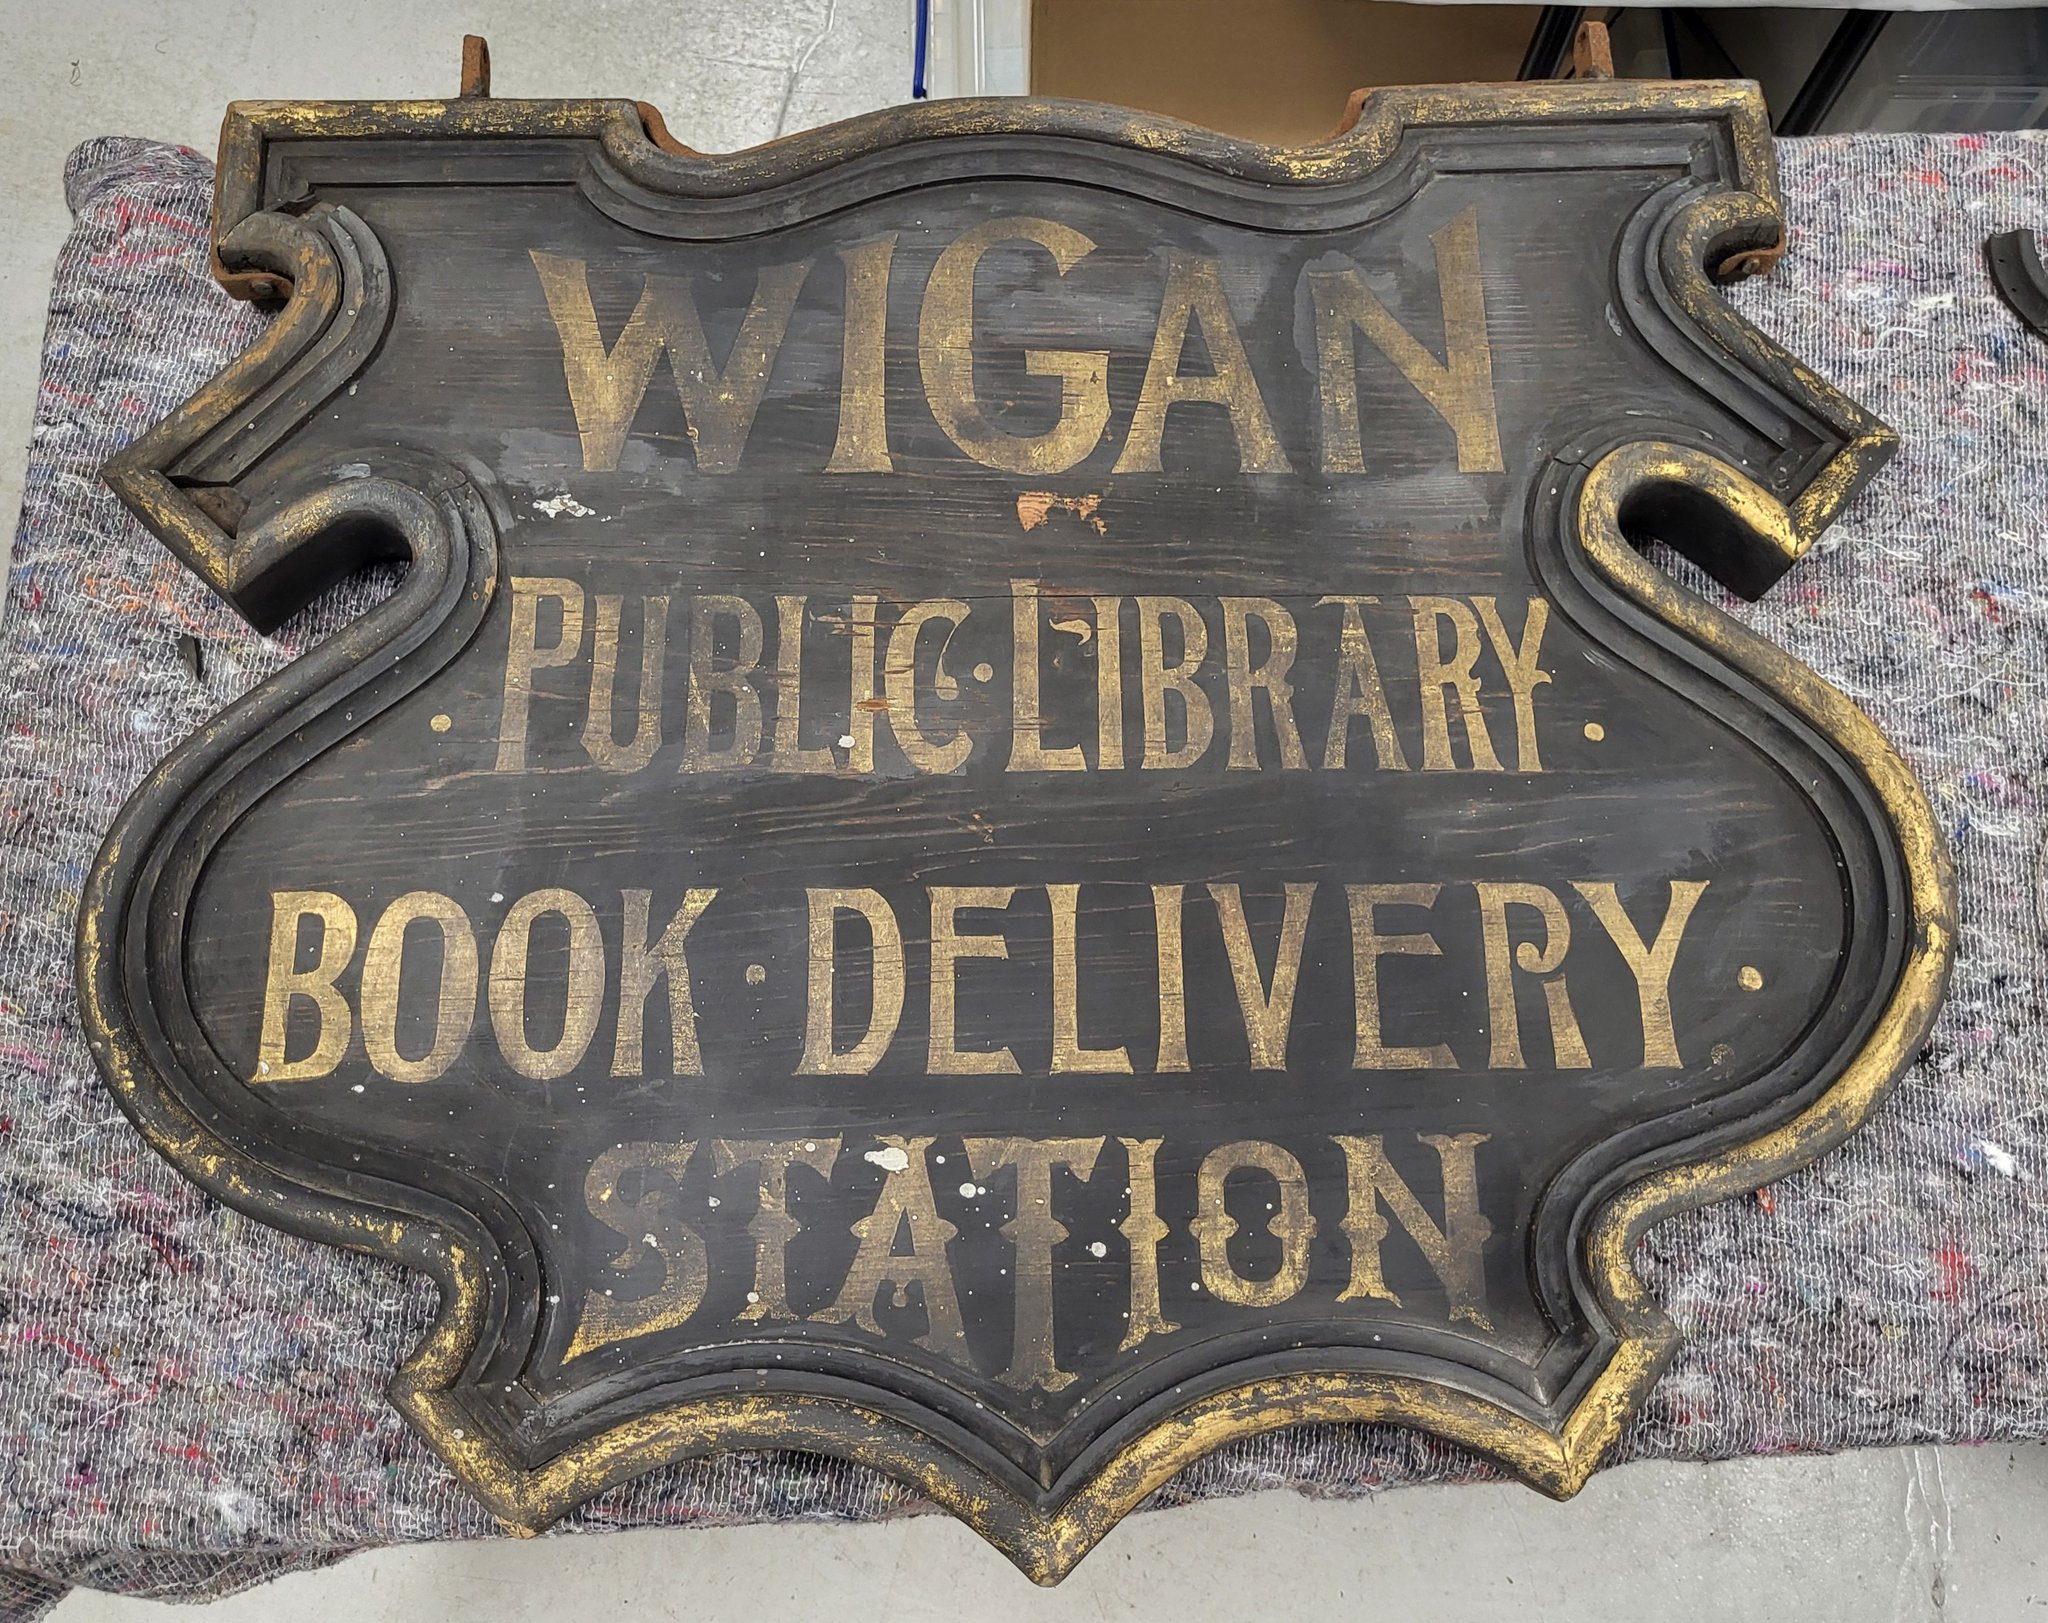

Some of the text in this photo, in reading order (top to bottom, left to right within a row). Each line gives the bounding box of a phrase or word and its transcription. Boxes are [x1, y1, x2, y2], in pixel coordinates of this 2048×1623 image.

[527, 204, 1506, 476] WIGAN
[494, 575, 1554, 777] PUBLIC LIBRARY
[250, 880, 1711, 1085] BOOK DELIVERY
[561, 1131, 1495, 1392] STATION
